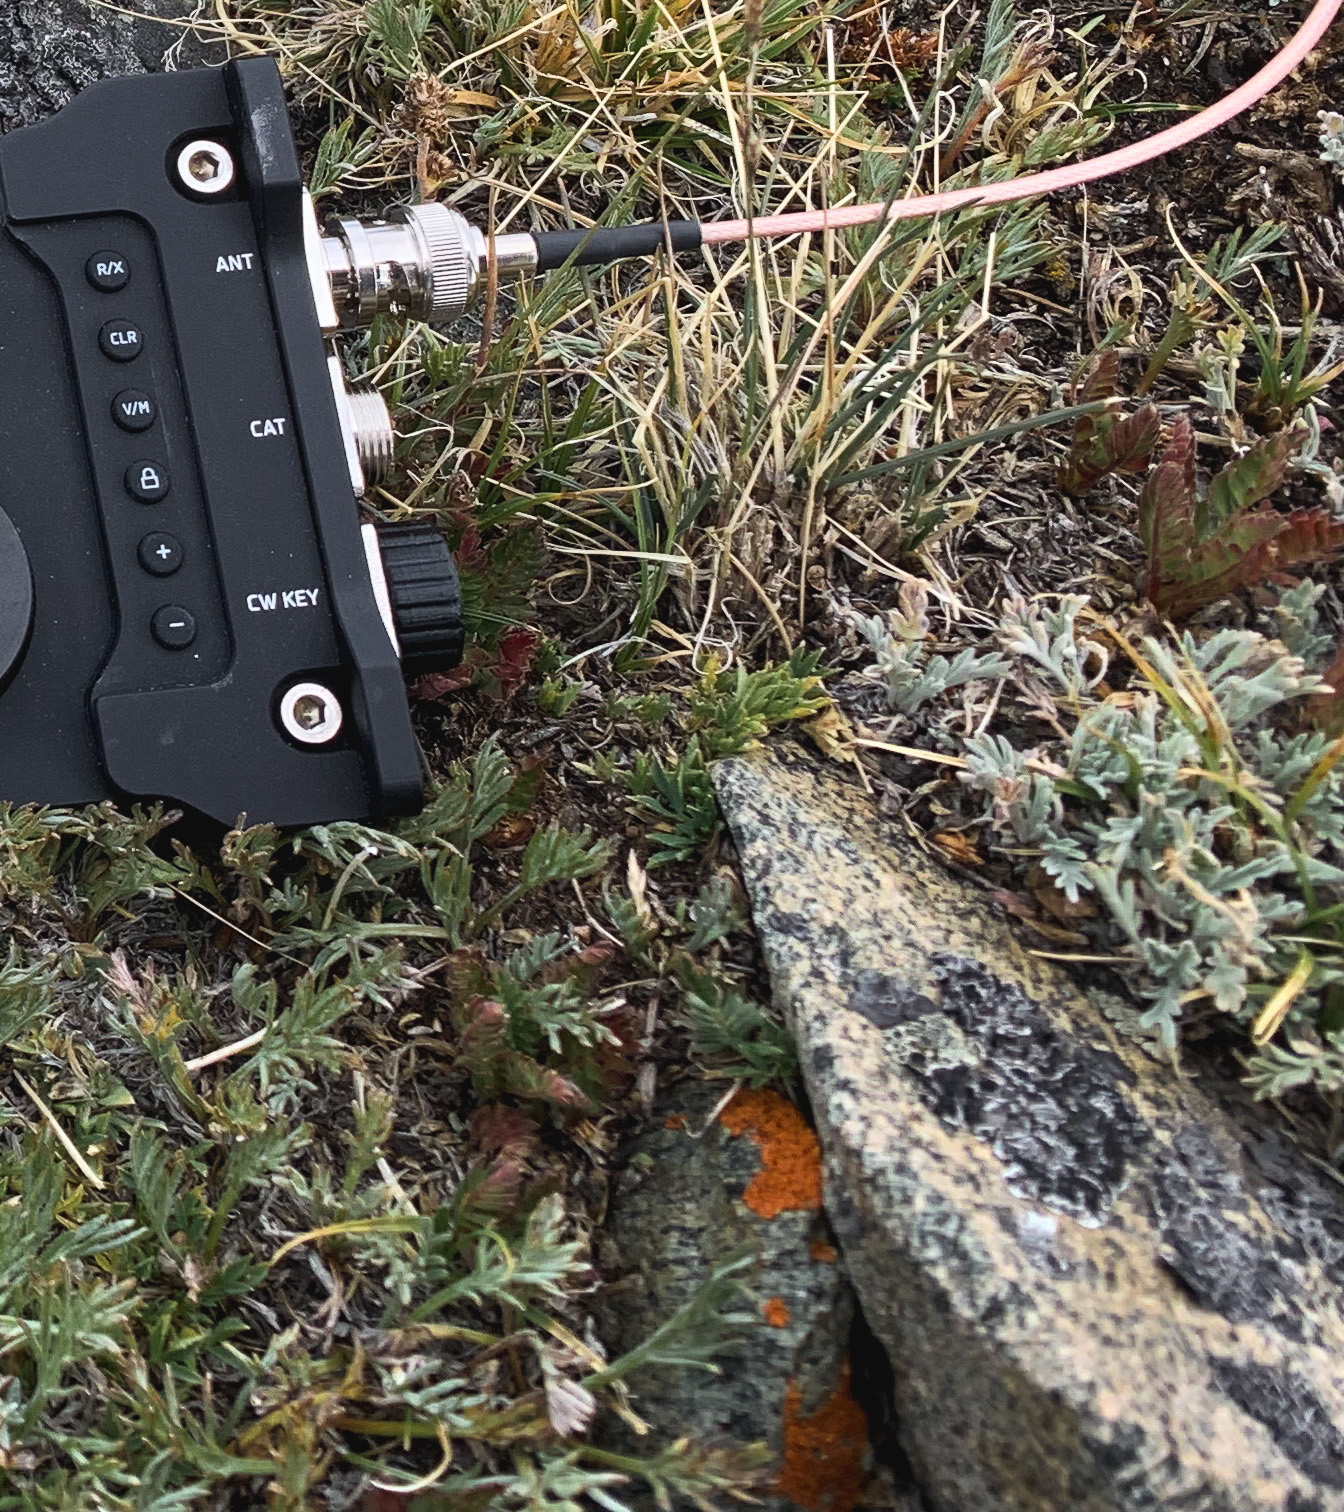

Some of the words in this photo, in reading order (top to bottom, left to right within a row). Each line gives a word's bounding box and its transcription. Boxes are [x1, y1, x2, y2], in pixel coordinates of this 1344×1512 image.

[97, 260, 125, 277] R/X
[216, 252, 254, 274] ANT
[109, 330, 138, 347] CLR
[121, 401, 151, 416] V/M
[250, 418, 287, 439] CAT
[246, 593, 278, 612] CW
[281, 587, 319, 609] KEY
